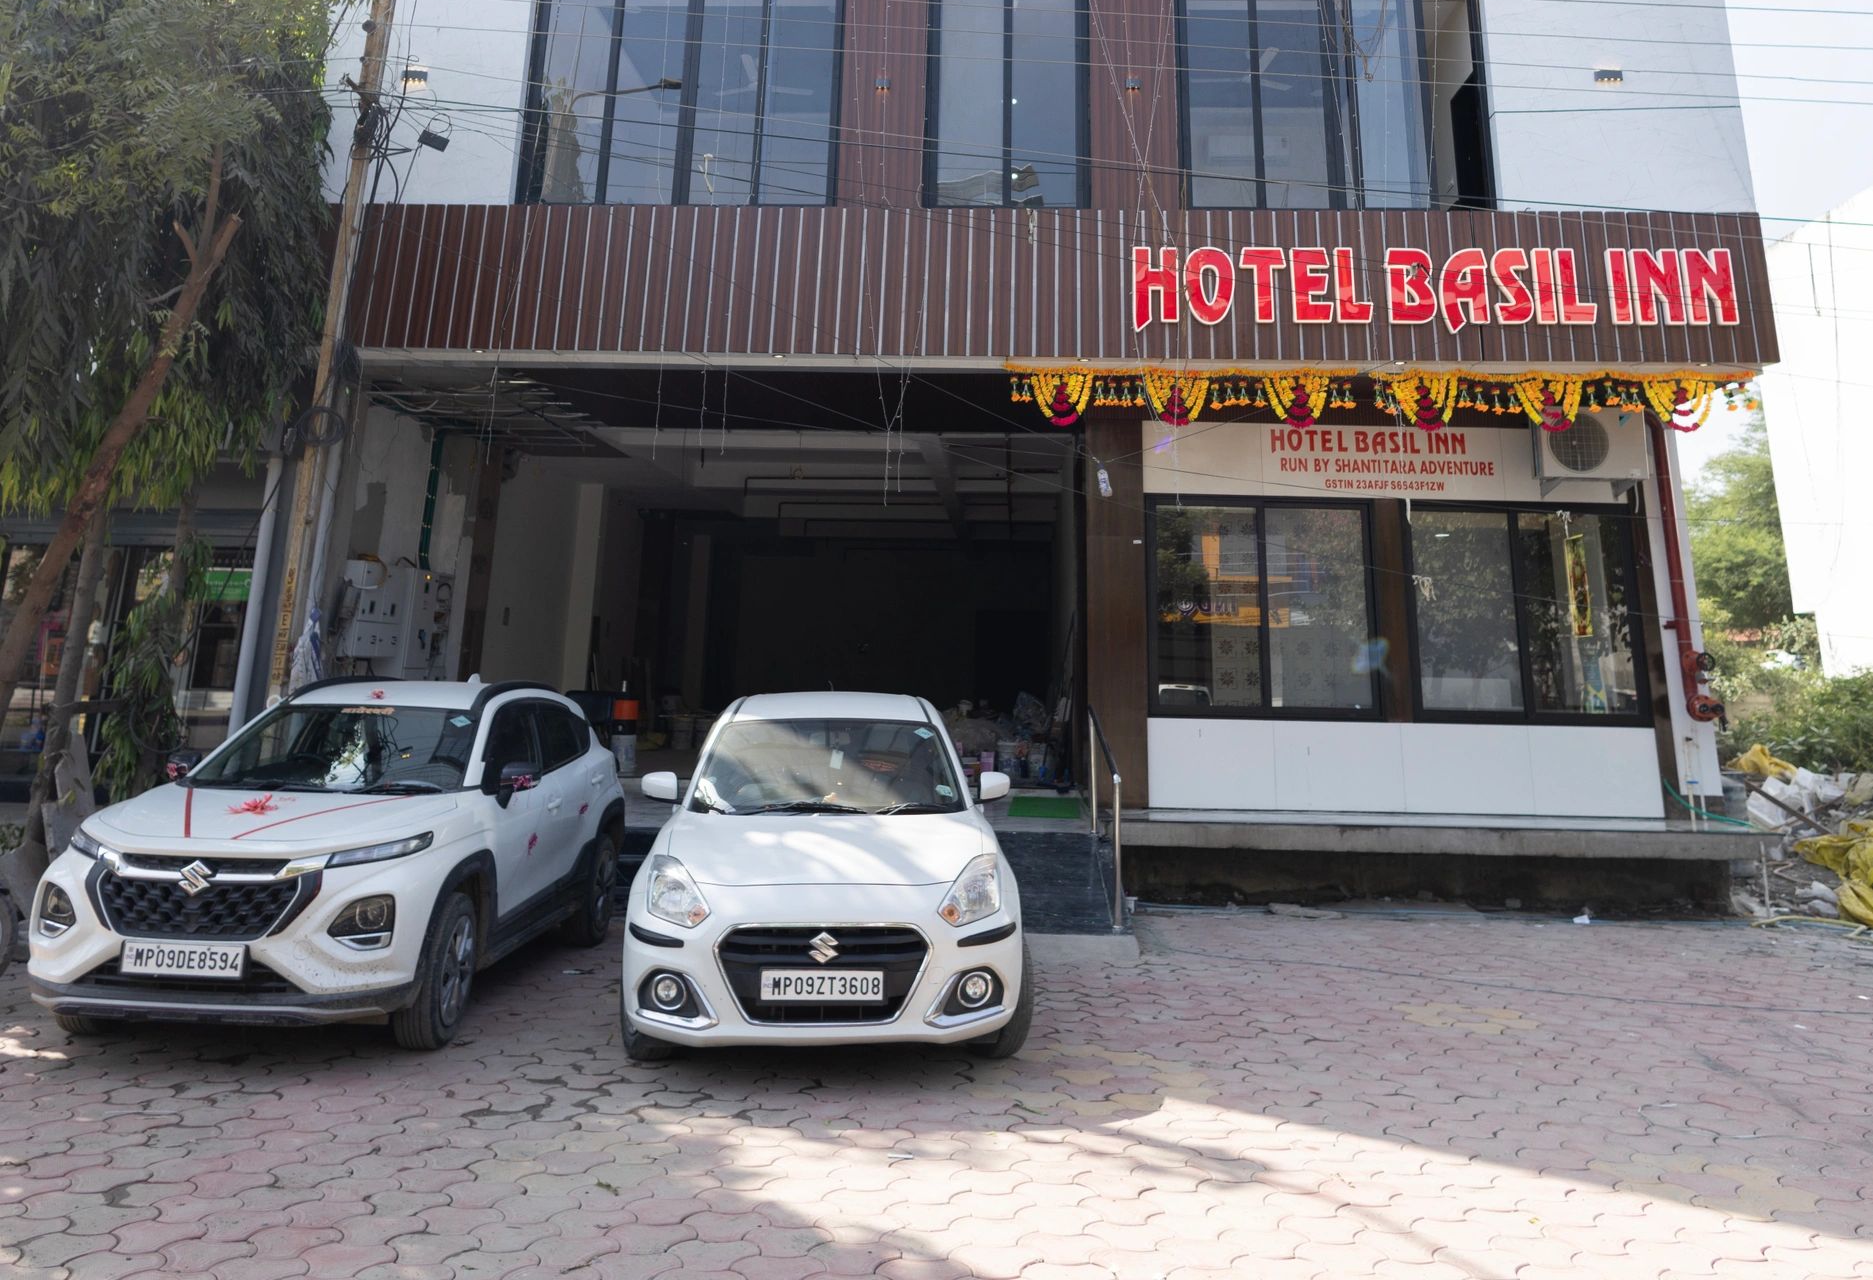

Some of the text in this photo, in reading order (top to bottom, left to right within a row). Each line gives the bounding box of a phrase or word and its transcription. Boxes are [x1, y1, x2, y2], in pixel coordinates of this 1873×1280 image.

[1132, 246, 1741, 335] HOTEL BASIL INN
[1270, 428, 1467, 455] HOTEL BASIL INN
[1280, 457, 1495, 477] RUN BY SHANTI TARA ADVENTURE
[1324, 478, 1354, 489] GSTIN
[133, 947, 240, 972] MP09DE8594
[772, 976, 881, 996] MP09ZT3608
